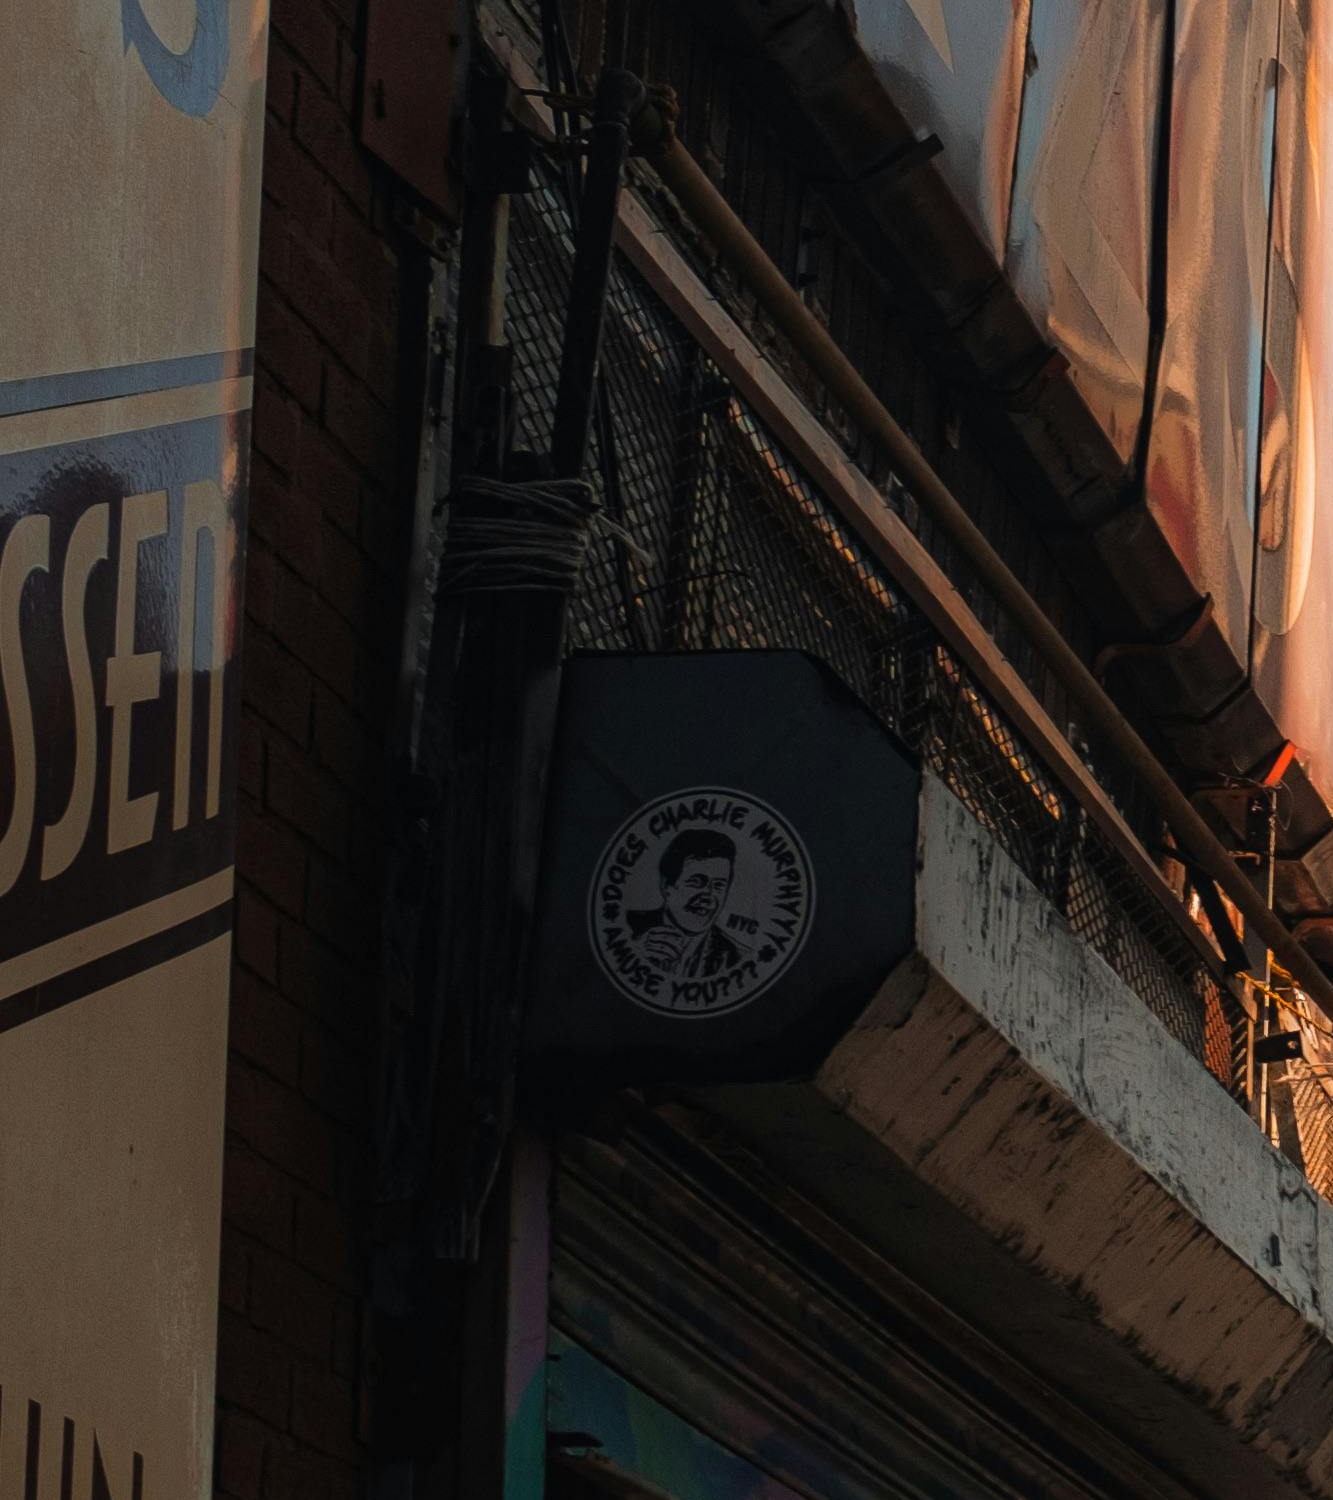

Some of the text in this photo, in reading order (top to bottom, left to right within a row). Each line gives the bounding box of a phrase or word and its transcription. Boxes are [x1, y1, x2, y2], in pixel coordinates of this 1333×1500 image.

[649, 798, 750, 839] CHARLIE
[726, 913, 759, 935] NYC
[603, 926, 758, 1007] AMUSE YOU???
